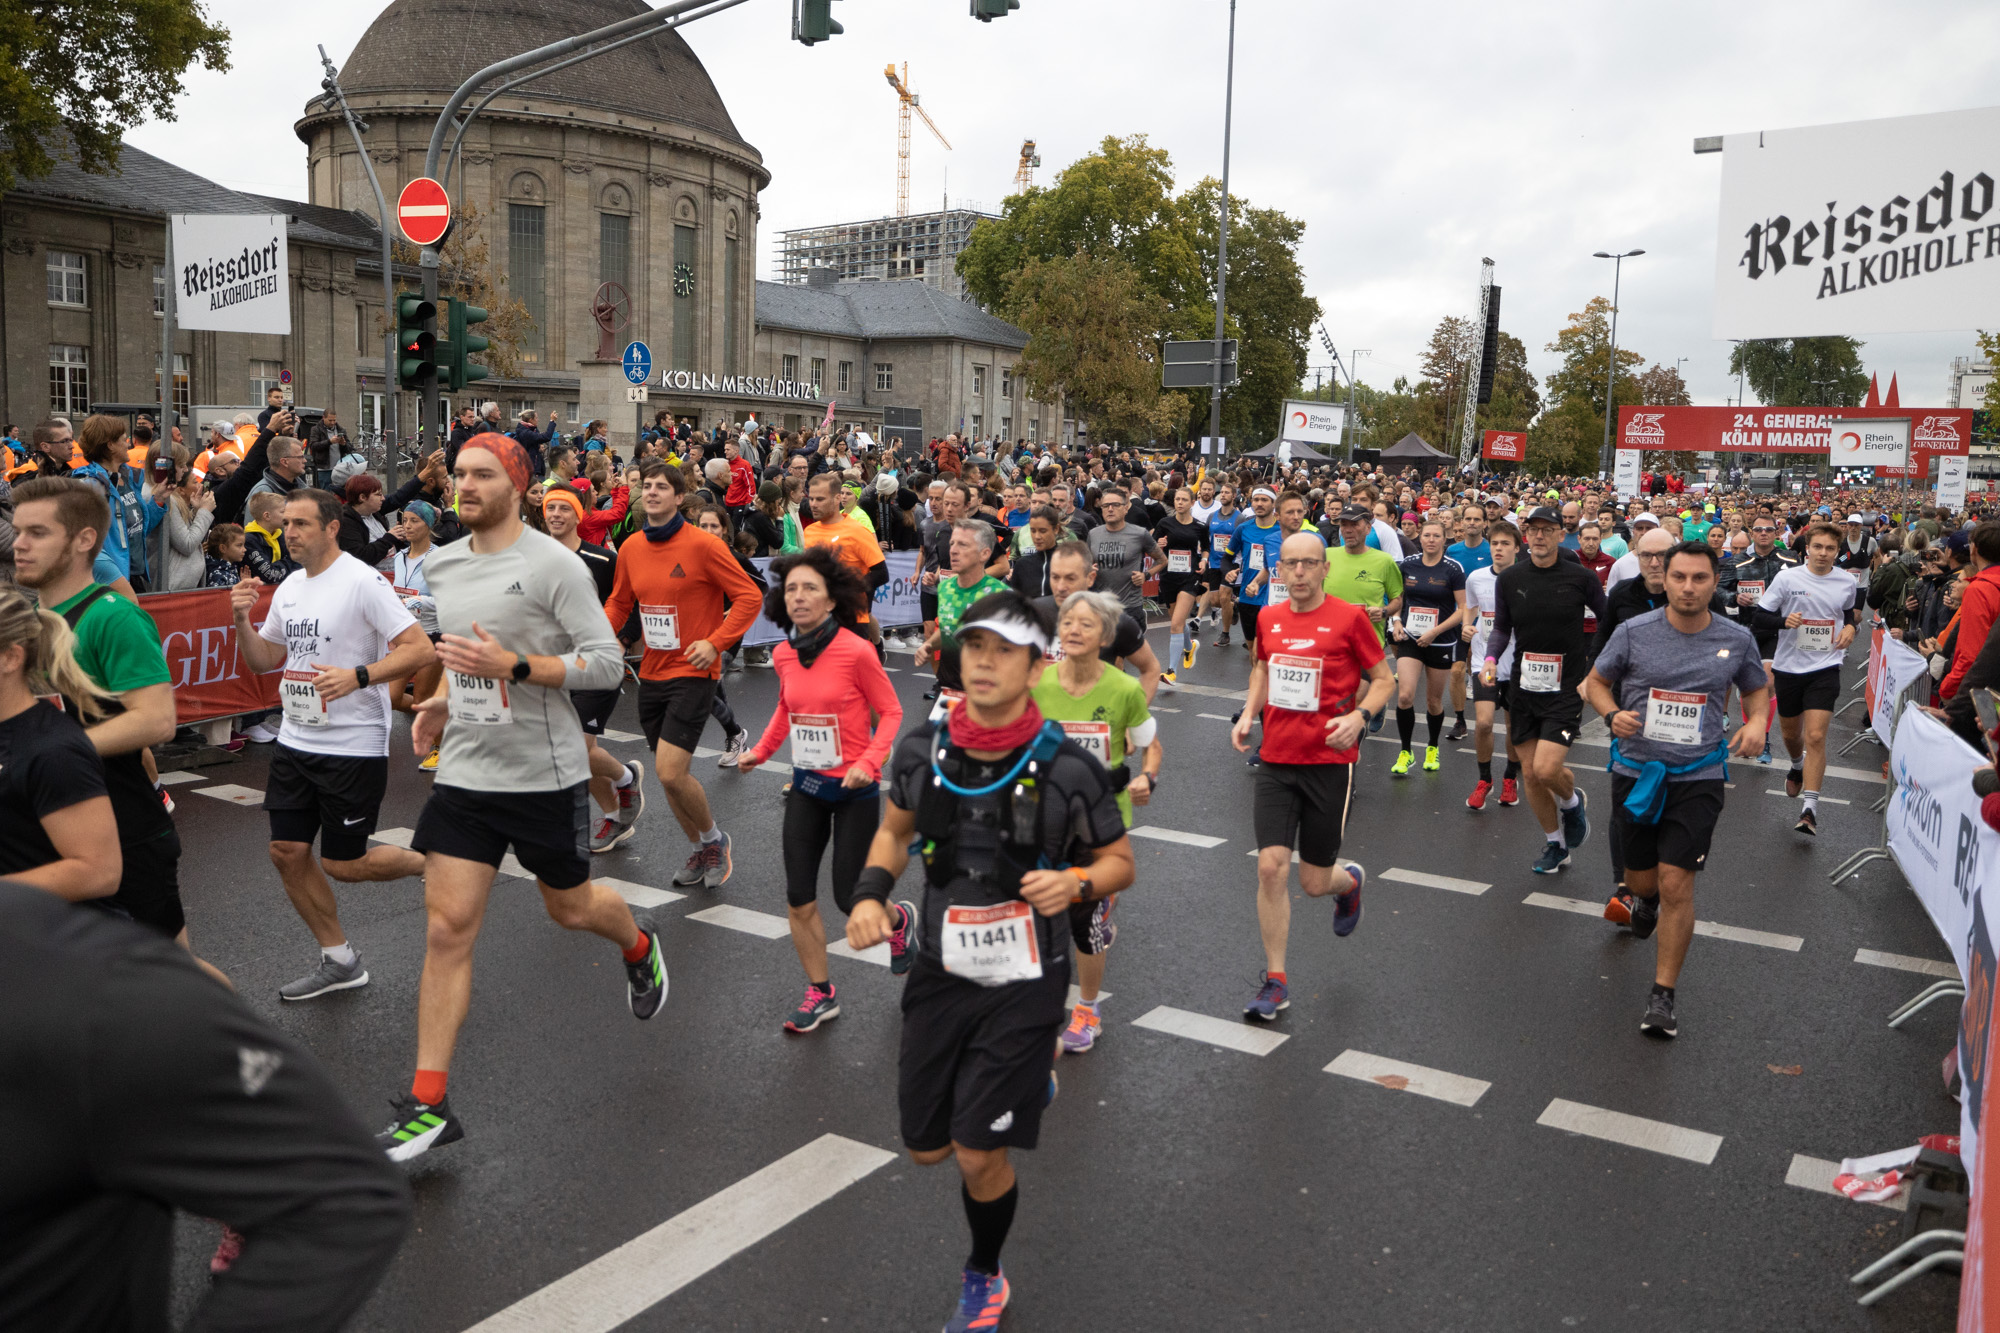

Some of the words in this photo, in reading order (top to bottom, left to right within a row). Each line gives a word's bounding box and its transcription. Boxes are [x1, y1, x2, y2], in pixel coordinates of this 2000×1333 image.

[1738, 170, 2000, 280] Reissdo
[183, 236, 278, 298] Reissdorf
[210, 274, 278, 312] ALKOHOLFREI
[661, 369, 715, 391] KÖLN
[1310, 414, 1331, 423] Rhein
[1733, 413, 1758, 428] 24.
[1309, 421, 1337, 432] Energie
[1625, 436, 1665, 445] GENERALI
[1721, 428, 1762, 446] KÖLN
[1865, 433, 1894, 442] Rhein
[1864, 442, 1903, 452] Energie
[1913, 441, 1960, 450] GENERALI
[1490, 450, 1517, 458] GENERALI
[1886, 467, 1918, 475] GENEALI
[1097, 553, 1125, 570] RUN
[644, 616, 670, 627] 11714
[1412, 614, 1432, 622] 13971
[286, 617, 321, 639] Gaffel
[1804, 626, 1830, 635] 16536
[1528, 663, 1554, 672] 15781
[454, 673, 494, 690] 16016
[1276, 668, 1311, 683] 13237
[285, 682, 315, 697] 10441
[1657, 703, 1698, 718] 12189
[1654, 719, 1695, 730] Francesco
[796, 729, 828, 742] 17811
[957, 924, 1017, 948] 11441
